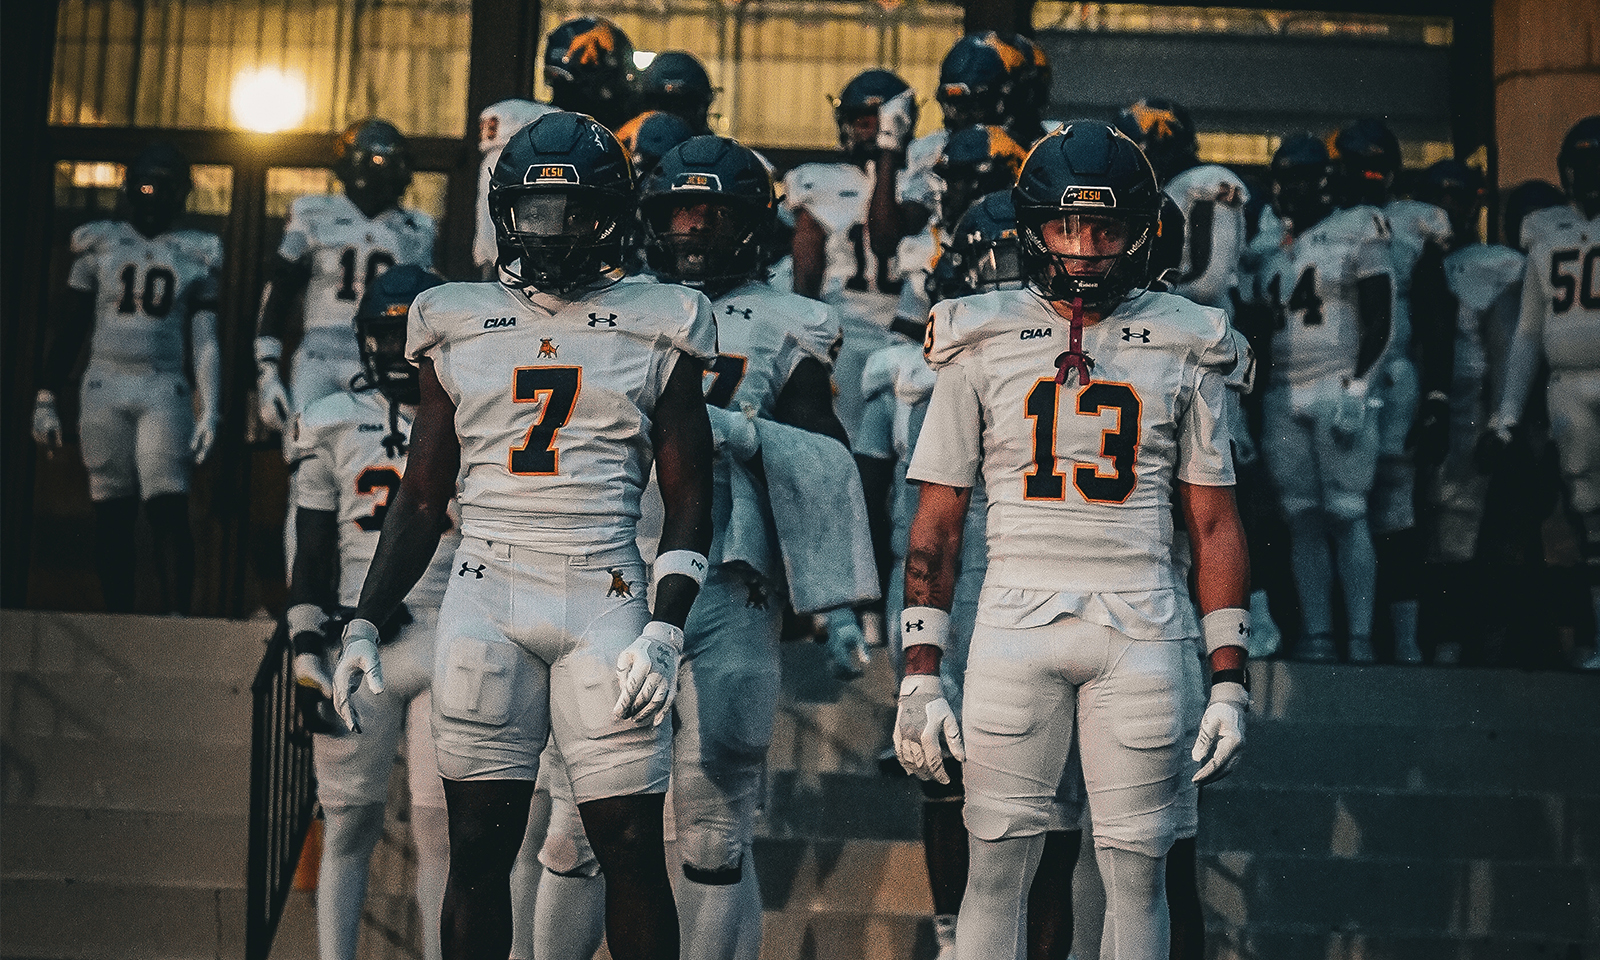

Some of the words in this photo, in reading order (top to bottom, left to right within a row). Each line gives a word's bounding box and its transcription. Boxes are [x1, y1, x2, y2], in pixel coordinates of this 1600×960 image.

[540, 167, 563, 178] JCSU
[1077, 190, 1101, 201] JCSU
[117, 263, 176, 319] 10
[1266, 264, 1323, 327] 14
[483, 317, 517, 329] CIAA
[1020, 327, 1053, 341] CIAA
[508, 364, 583, 476] 7
[1023, 376, 1144, 505] 13
